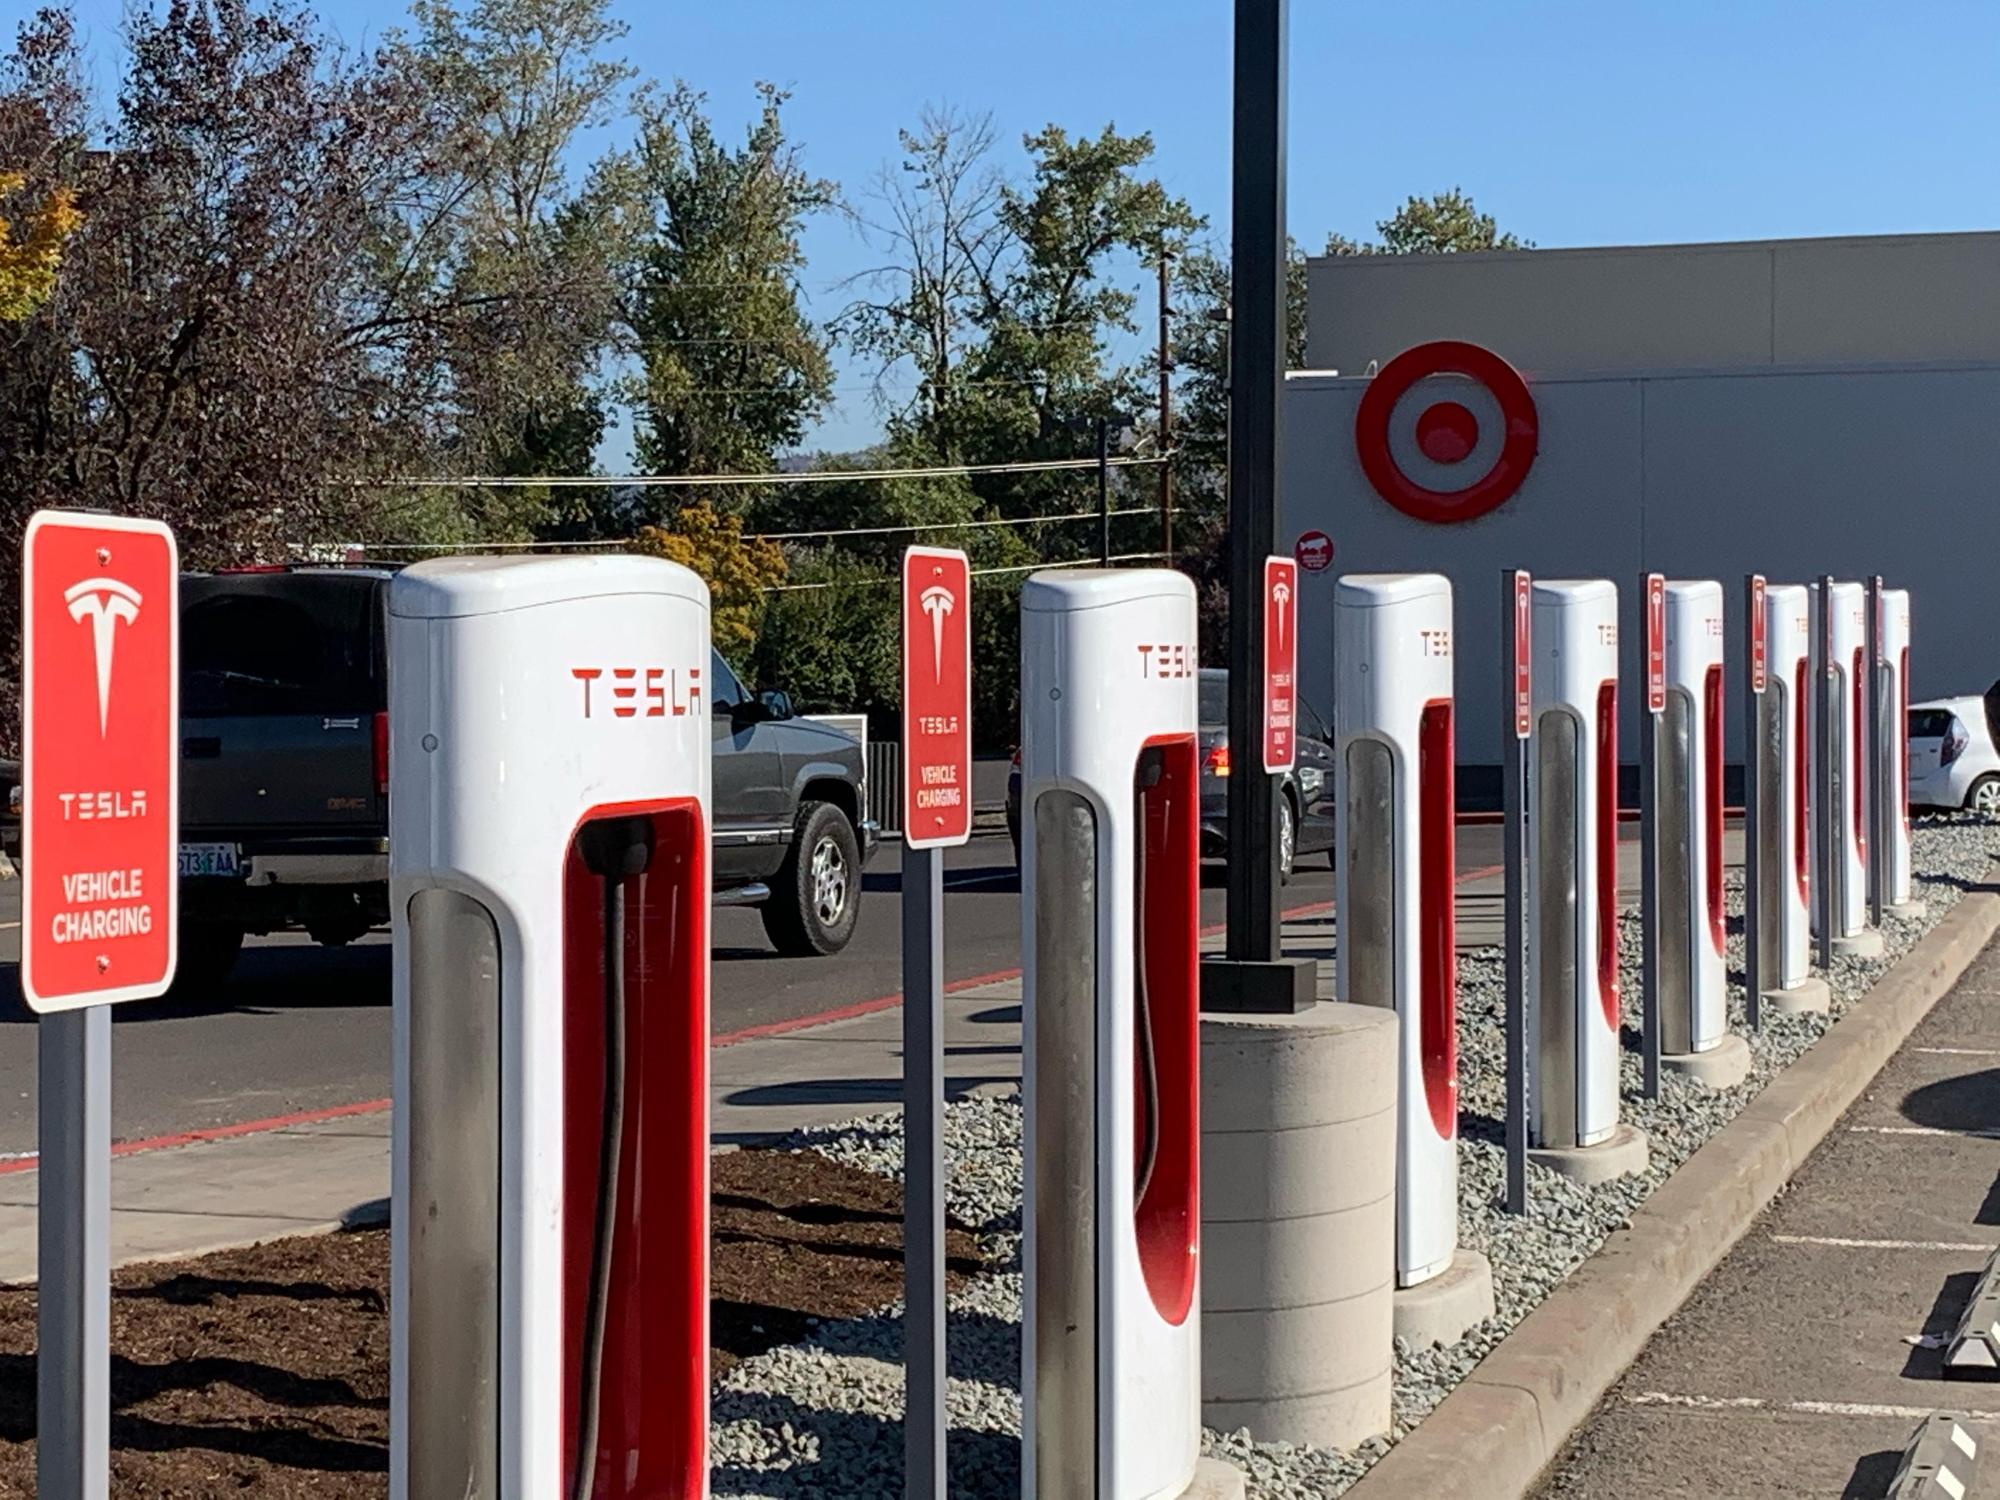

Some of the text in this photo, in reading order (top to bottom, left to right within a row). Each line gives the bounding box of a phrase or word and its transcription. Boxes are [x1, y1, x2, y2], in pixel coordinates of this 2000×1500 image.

[1420, 631, 1449, 656] TES
[571, 668, 701, 718] TESLA
[919, 716, 958, 735] TESLA
[921, 765, 957, 785] VEHICLE
[58, 790, 147, 820] TESLA
[62, 868, 143, 904] VEHICLE
[51, 905, 152, 944] CHARGING
